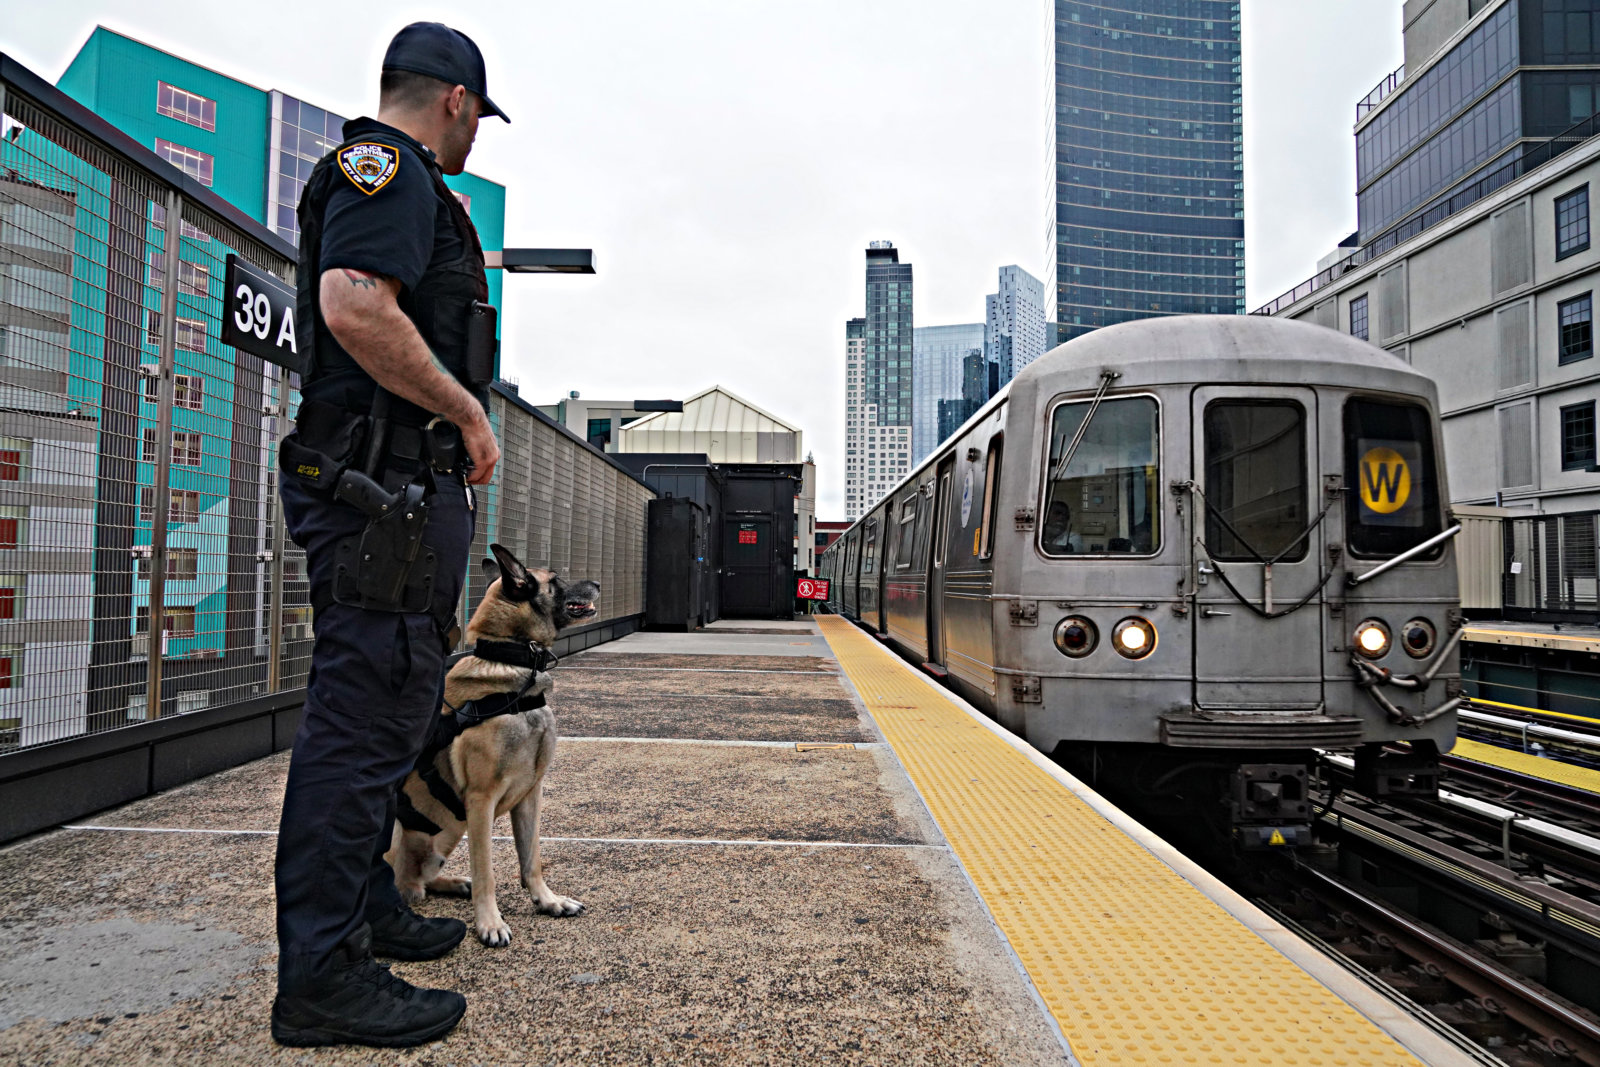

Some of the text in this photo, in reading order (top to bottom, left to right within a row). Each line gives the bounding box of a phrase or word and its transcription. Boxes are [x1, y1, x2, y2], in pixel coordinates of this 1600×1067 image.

[343, 149, 393, 160] DEPARTMENT
[343, 162, 363, 183] CITY OF
[373, 162, 395, 187] NEW YORK
[234, 284, 297, 354] 39 A
[1362, 461, 1404, 503] W
